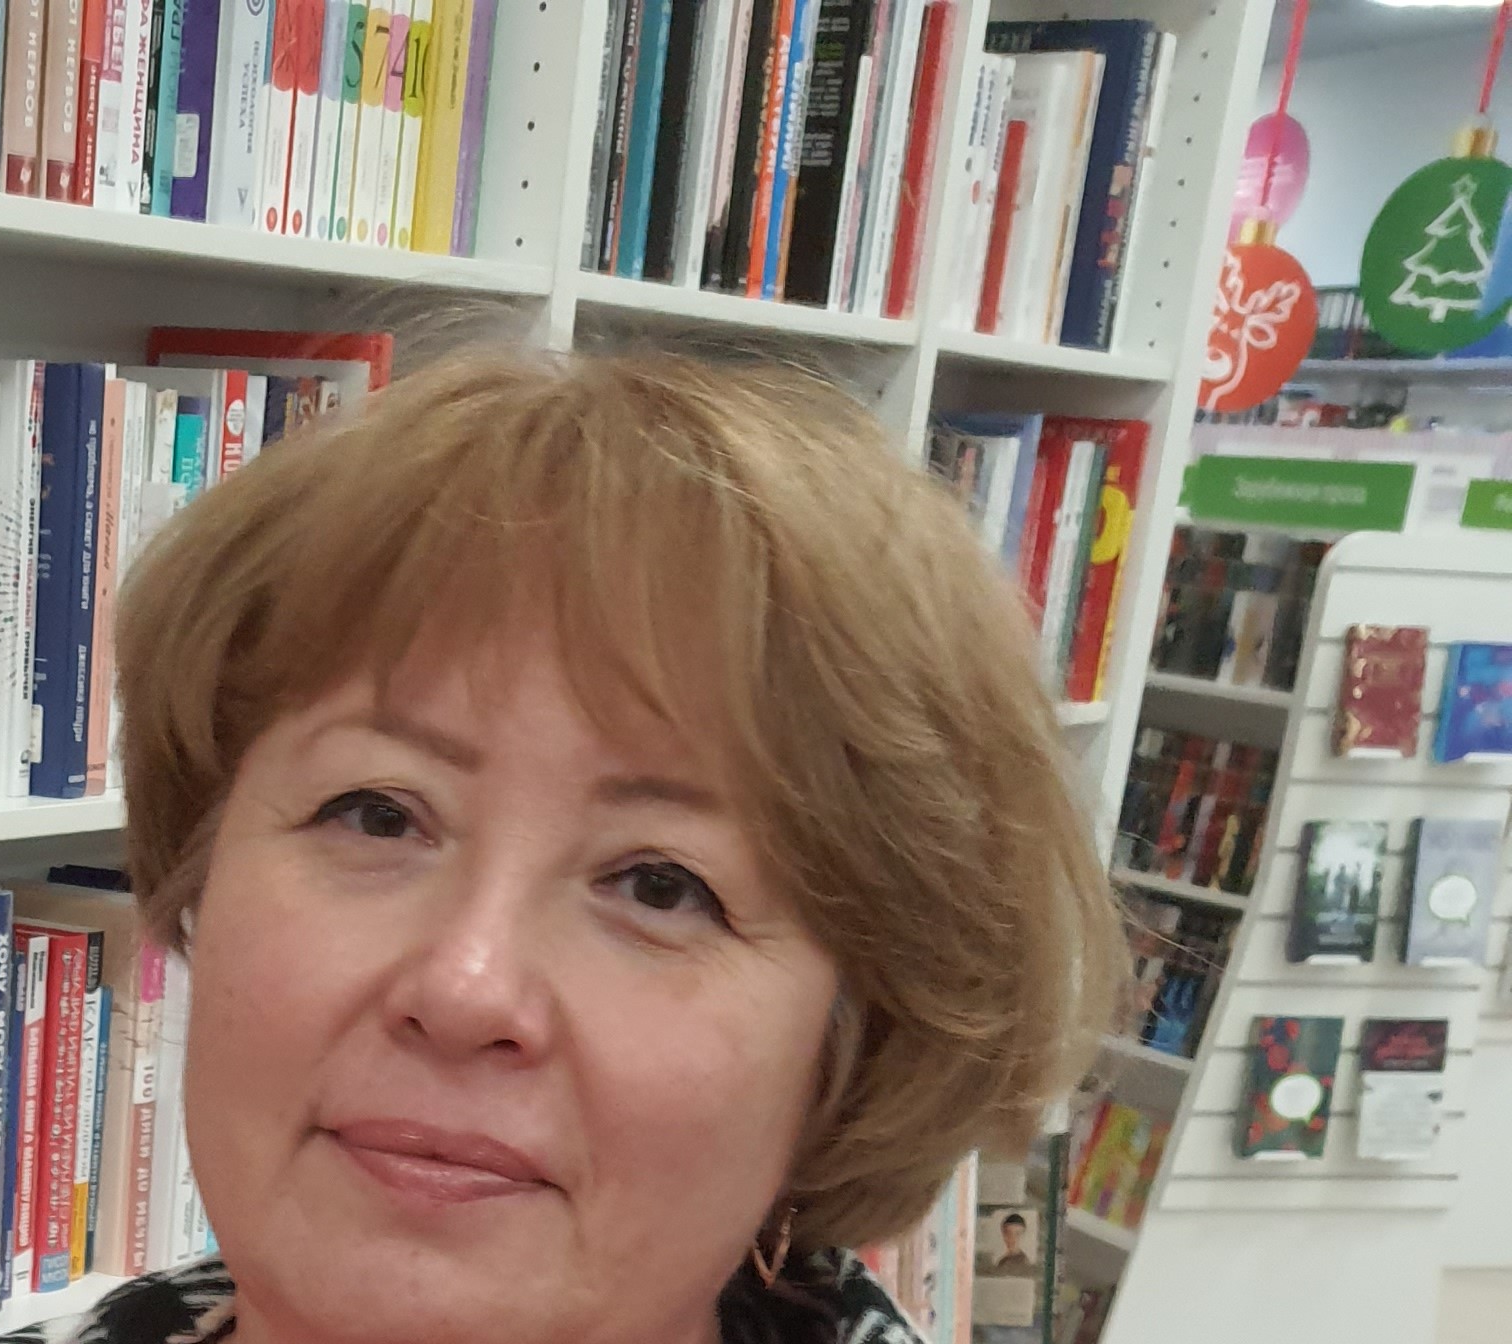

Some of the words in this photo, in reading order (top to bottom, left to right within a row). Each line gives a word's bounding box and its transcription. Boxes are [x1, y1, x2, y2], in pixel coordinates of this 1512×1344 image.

[22, 31, 38, 128] НЕРВОВ
[62, 38, 76, 134] НЕРВОВ
[131, 34, 148, 165] ЖЕНЩИНА
